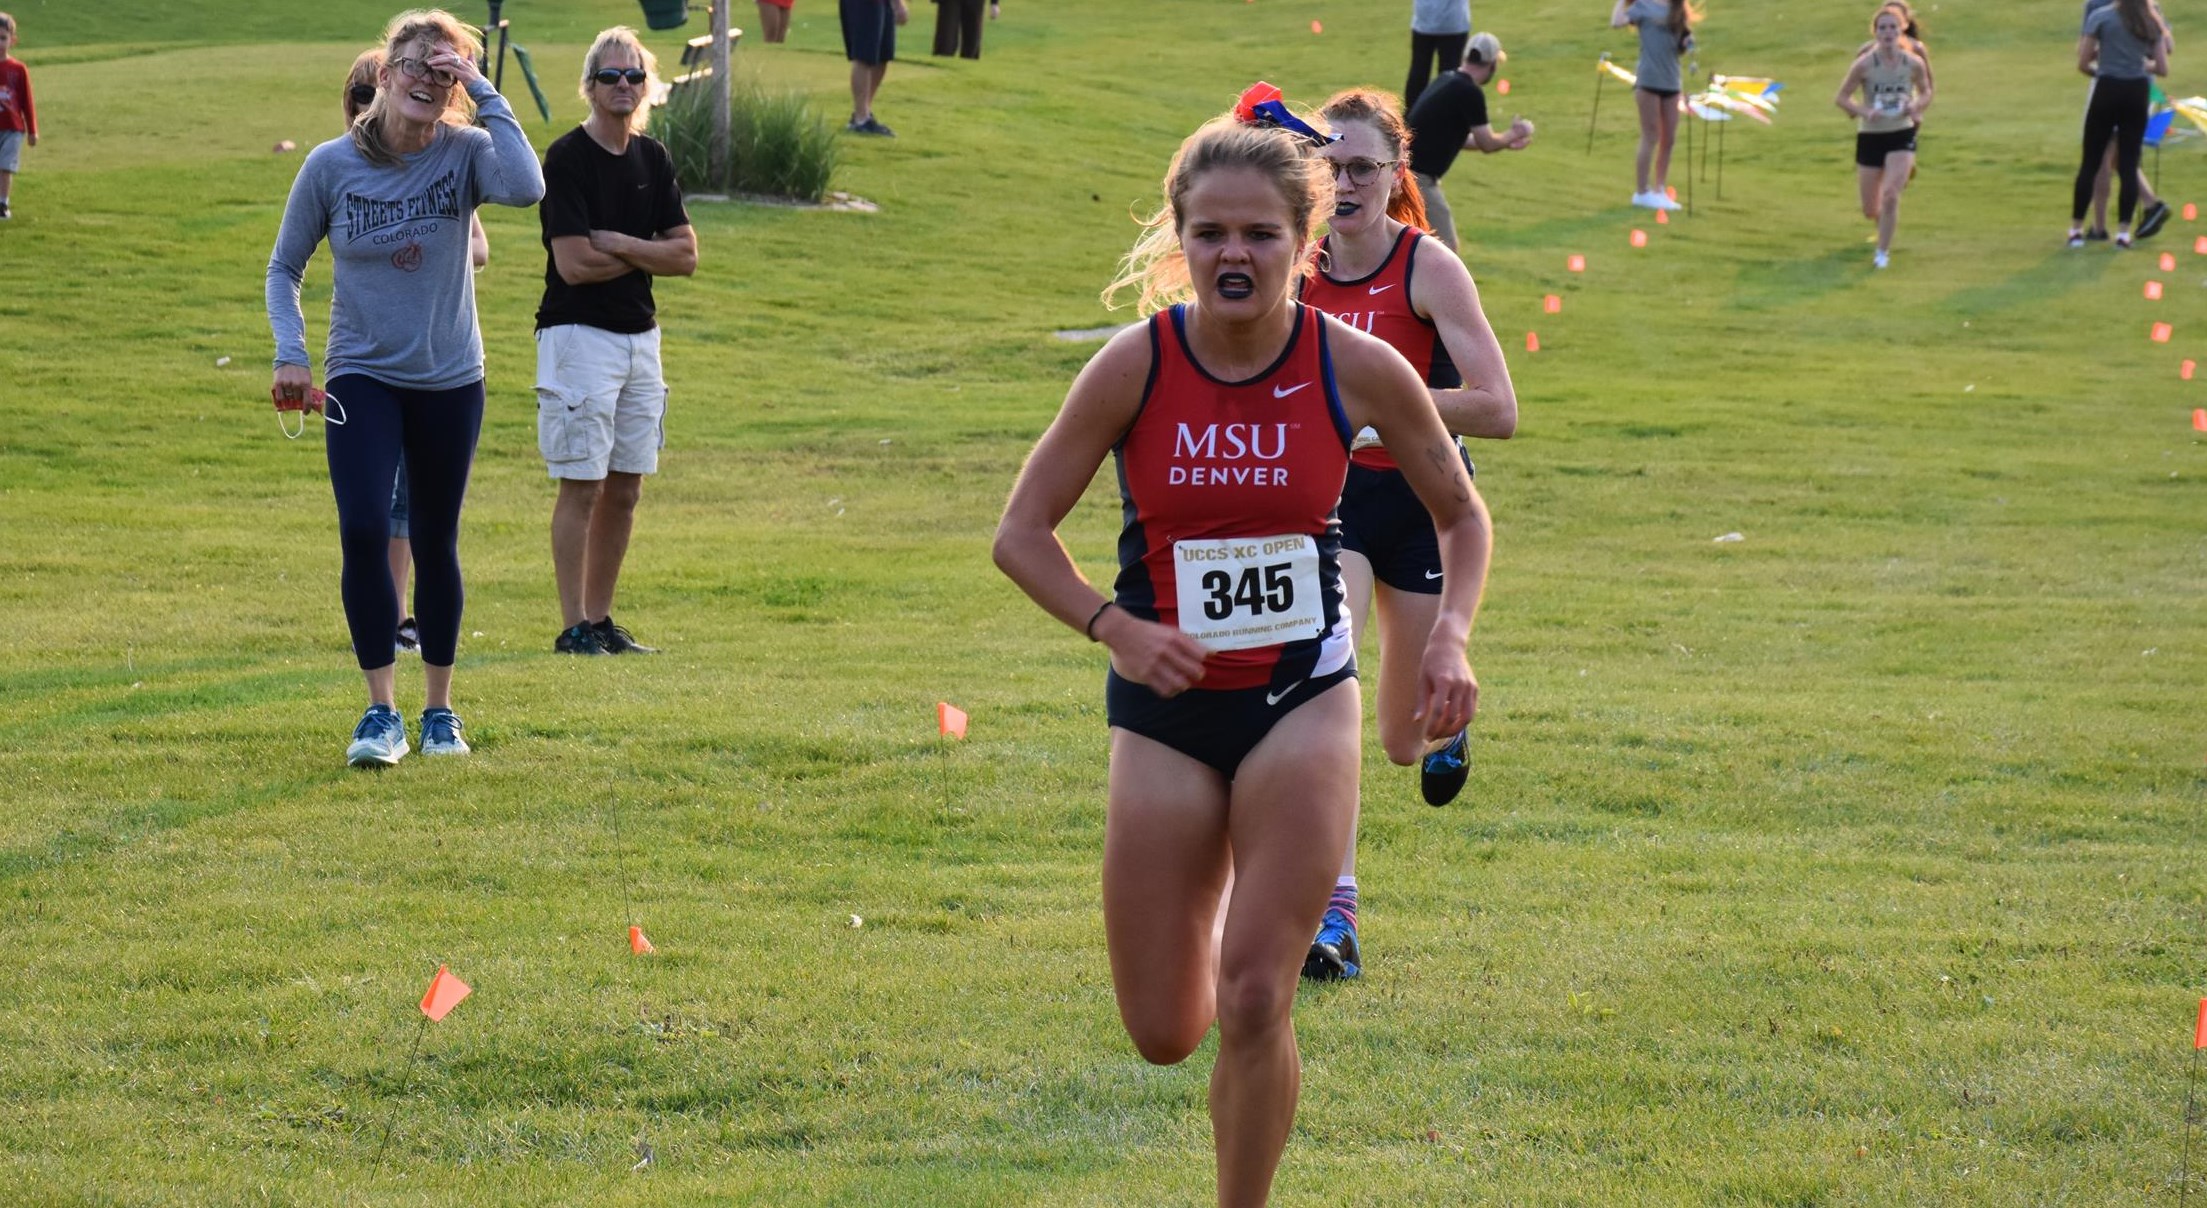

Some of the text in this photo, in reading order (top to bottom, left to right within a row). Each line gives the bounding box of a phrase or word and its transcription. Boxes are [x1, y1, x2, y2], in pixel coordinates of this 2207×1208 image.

[346, 169, 460, 241] STREETS FITNESS
[372, 222, 438, 245] COLORADO
[1173, 422, 1287, 459] MSU
[1168, 466, 1289, 487] DENVER
[1183, 537, 1305, 562] UCCS XC OPEN
[1202, 562, 1294, 620] 345
[1232, 625, 1273, 636] RUNNING
[1274, 617, 1317, 630] COMPANY
